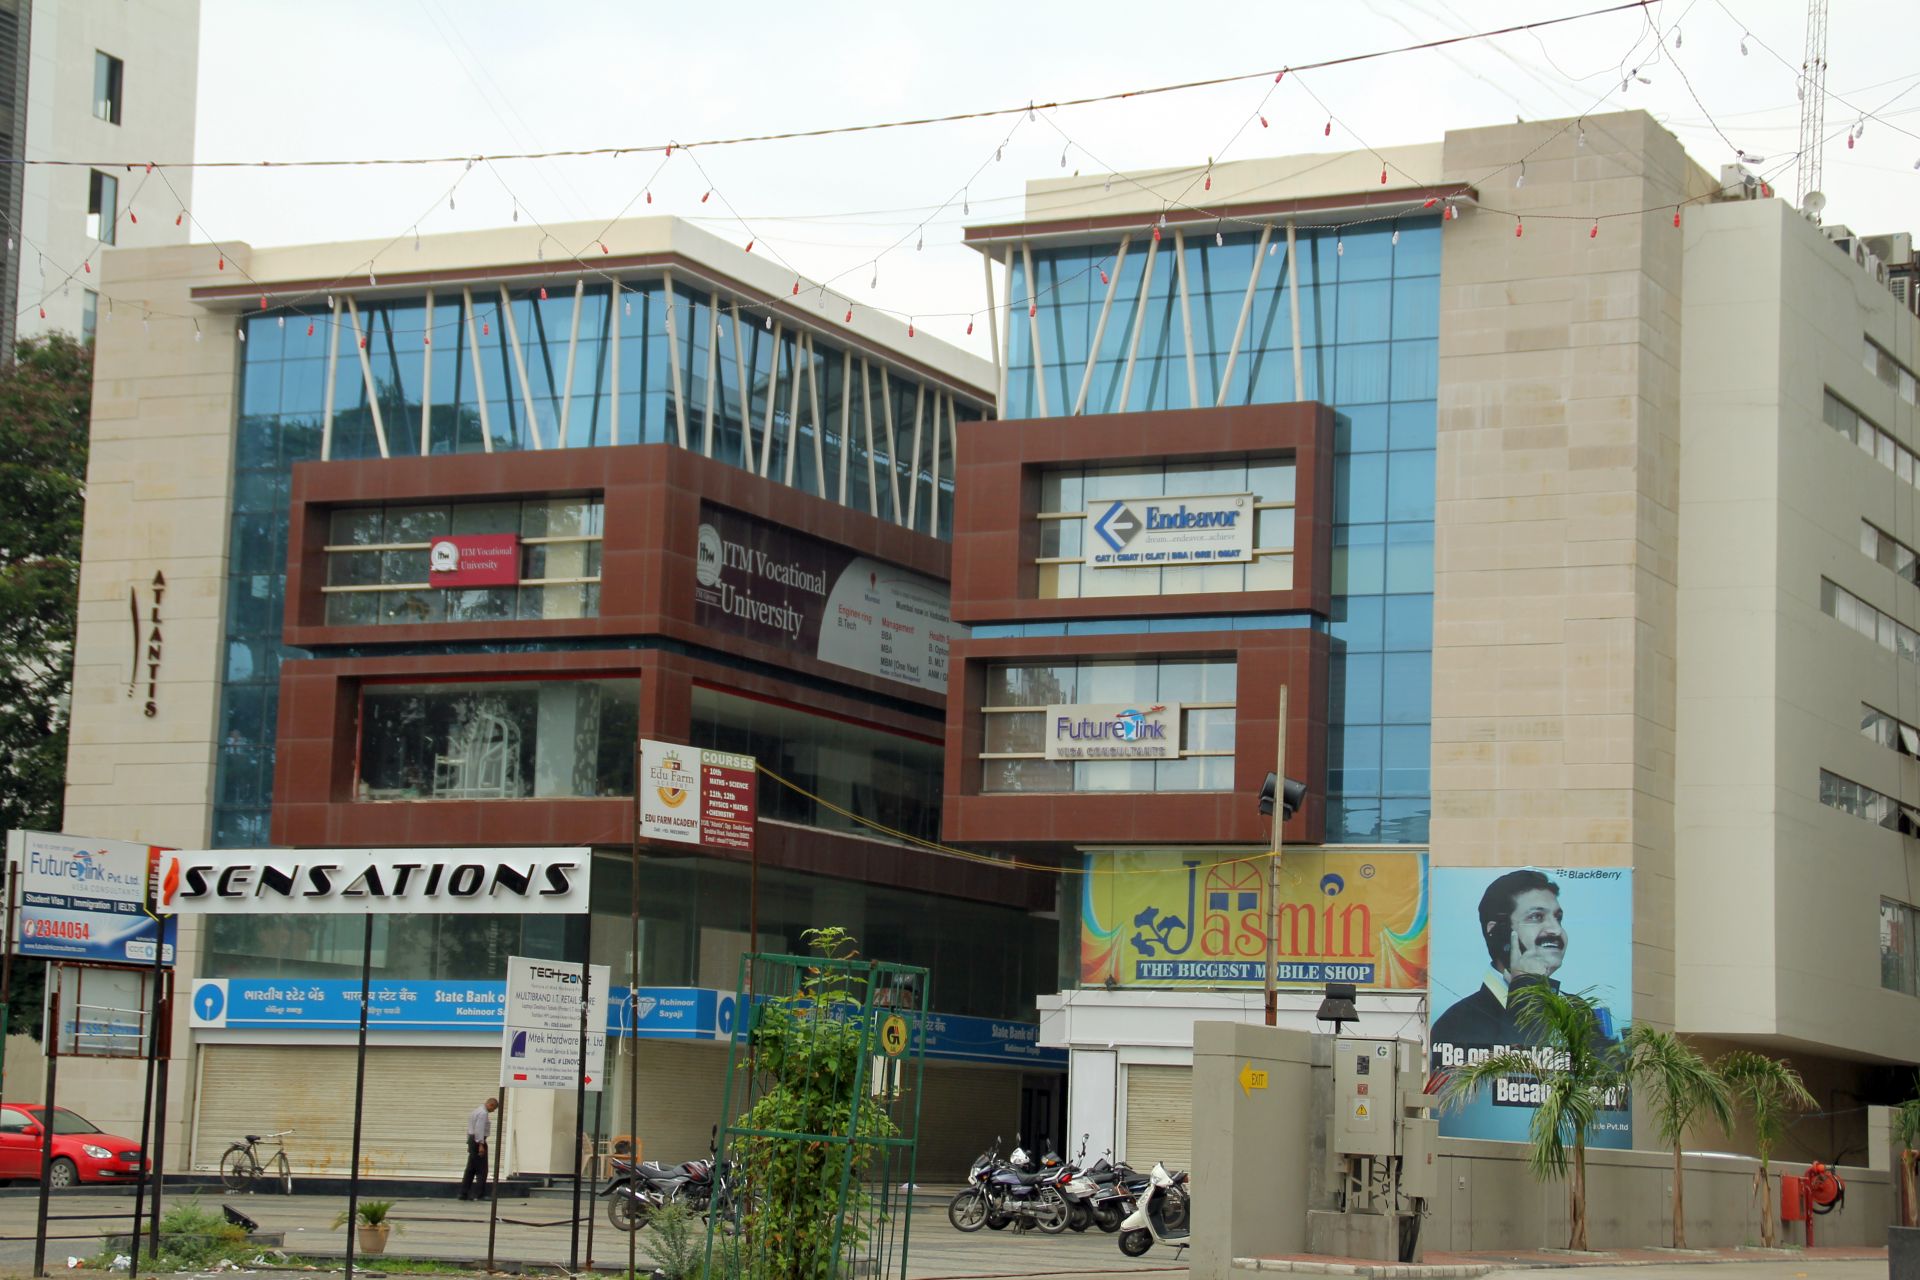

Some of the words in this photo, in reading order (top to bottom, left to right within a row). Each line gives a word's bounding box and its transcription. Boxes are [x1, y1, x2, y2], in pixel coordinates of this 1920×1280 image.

[1146, 505, 1240, 530] Endeavor
[461, 548, 475, 557] ITM
[476, 546, 512, 556] Vocational
[1095, 554, 1111, 562] CAT
[1117, 553, 1139, 562] CMAT
[1145, 552, 1166, 560] CLAT
[1218, 549, 1241, 558] GMAT
[461, 560, 497, 570] University
[723, 540, 753, 573] ITM
[756, 551, 827, 597] Vocational
[721, 583, 804, 640] University
[881, 617, 915, 635] Management
[881, 630, 892, 641] BBA
[144, 570, 166, 718] ATLANTIS
[881, 643, 892, 654] MBA
[880, 657, 893, 667] MBM
[1057, 747, 1084, 757] VISA
[1087, 746, 1166, 757] CONSULTANTS
[703, 751, 754, 770] COURSES
[650, 767, 668, 780] Edu
[671, 771, 694, 784] Farm
[710, 768, 722, 776] 10th
[709, 778, 725, 787] MATHS
[729, 781, 749, 790] SCIENCE
[709, 800, 728, 809] PHYSICS
[733, 803, 748, 812] MATHS
[645, 814, 656, 823] EDU
[657, 815, 672, 826] FARM
[673, 817, 698, 829] ACADEMY
[107, 873, 122, 884] Pvt.
[125, 875, 140, 886] Ltd.
[180, 862, 580, 898] SENSATIONS
[1569, 870, 1622, 880] BlackBerry
[26, 894, 50, 905] Student
[51, 896, 64, 906] Visa
[73, 899, 111, 911] Immigration
[118, 903, 136, 912] IELTS
[1131, 859, 1375, 958] Jasmin
[36, 919, 89, 940] 2344054
[1141, 963, 1172, 977] THE
[1178, 963, 1250, 979] BIGGEST
[1324, 965, 1370, 981] SHOP
[435, 990, 464, 1003] State
[466, 990, 496, 1003] Bank
[515, 992, 551, 1003] MULTIBRAND
[561, 995, 577, 1004] RETAIL
[660, 998, 695, 1007] Kohinoor
[456, 1007, 496, 1016] Kohinoor
[659, 1009, 683, 1019] Sayaji
[1010, 1025, 1025, 1040] Bank
[528, 1033, 545, 1044] Mtek
[546, 1034, 579, 1046] Hardware
[593, 1036, 604, 1047] Ltd.
[1251, 1074, 1265, 1086] EXIT
